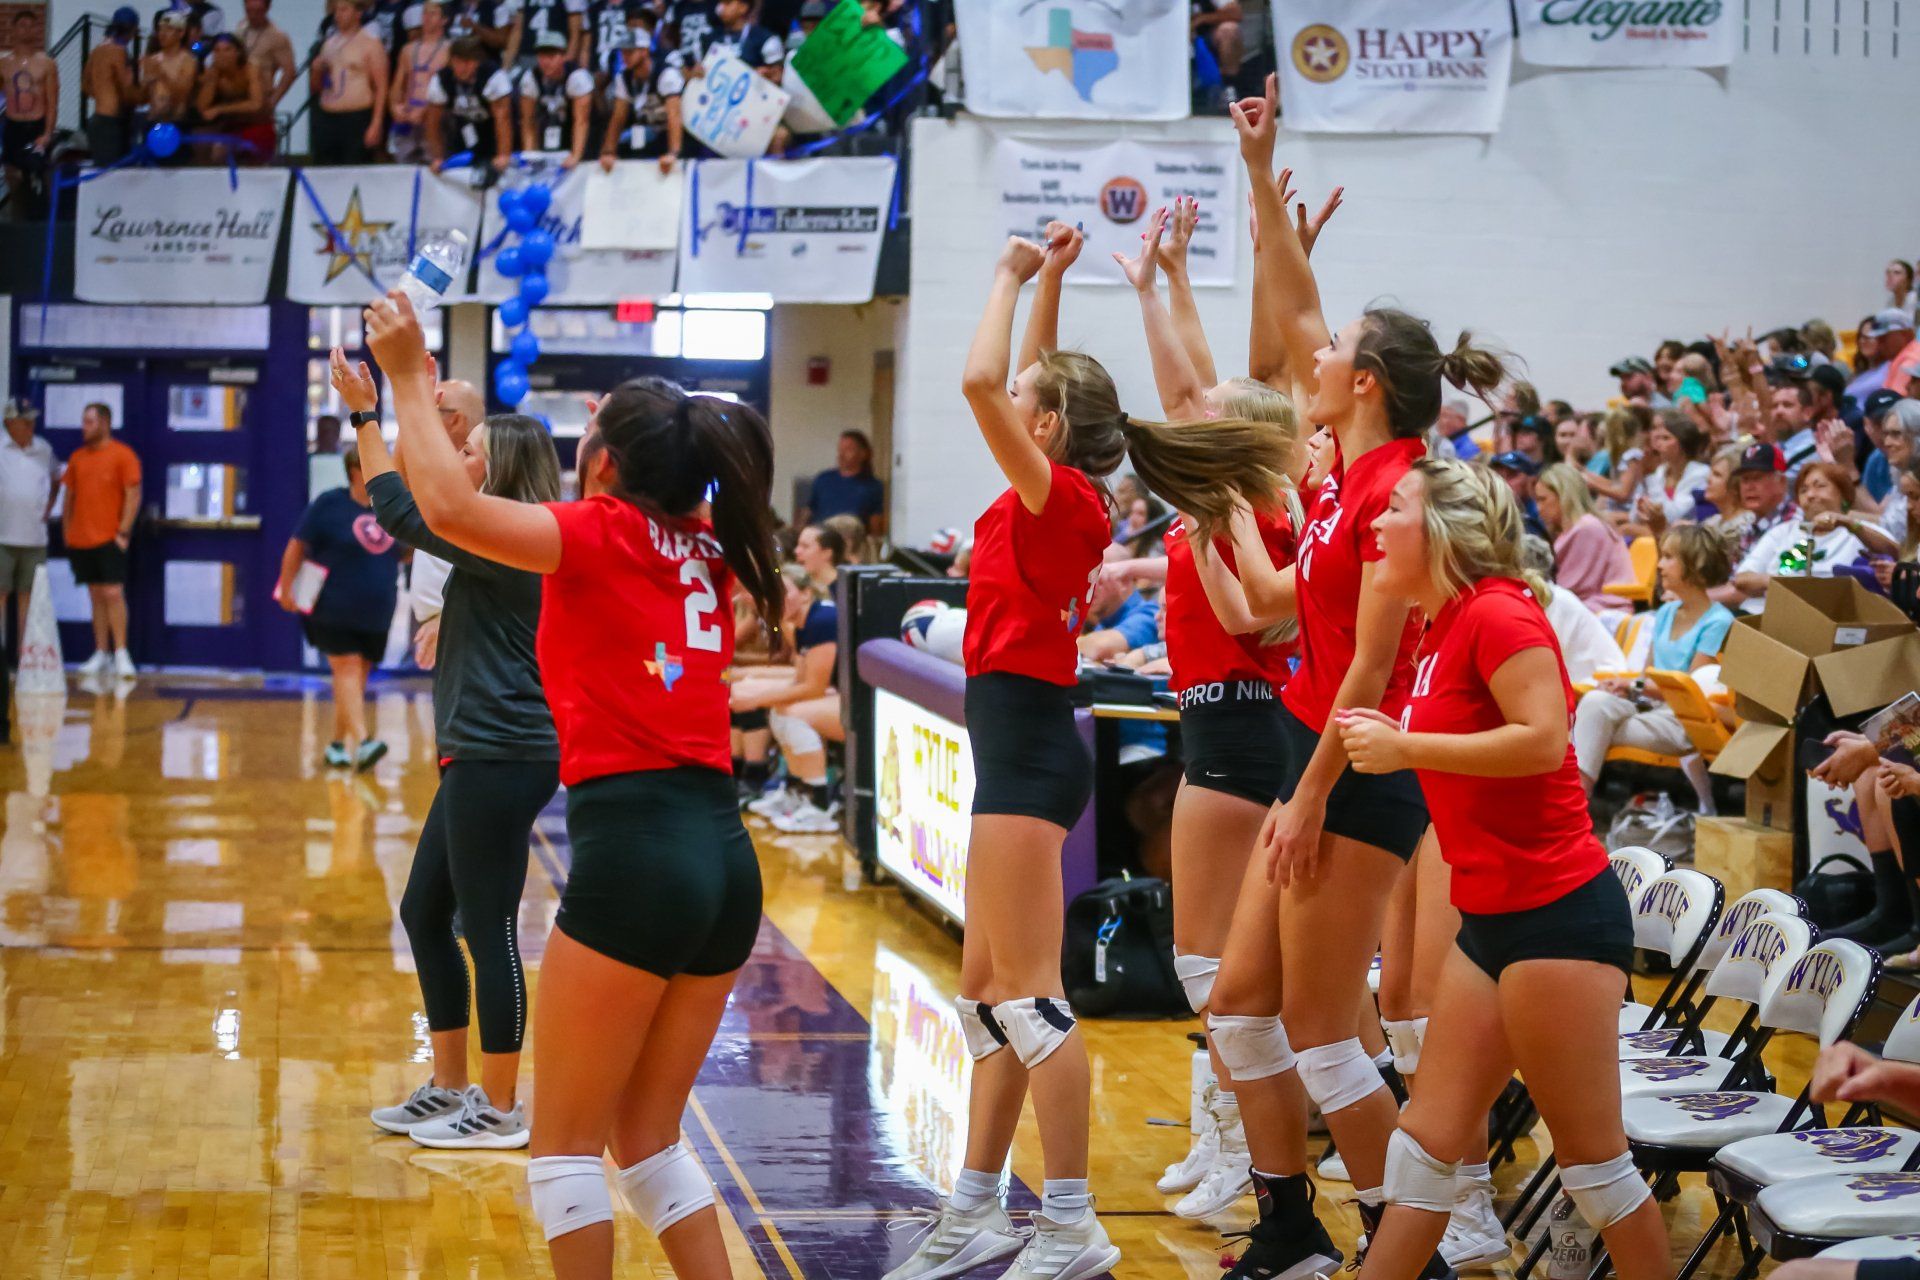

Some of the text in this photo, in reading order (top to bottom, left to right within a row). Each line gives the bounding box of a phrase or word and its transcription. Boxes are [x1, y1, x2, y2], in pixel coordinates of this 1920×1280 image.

[1356, 28, 1490, 60] HAPPY
[1355, 61, 1487, 80] STATE BANK
[1108, 189, 1138, 216] W
[91, 206, 275, 243] Lawrence Hall
[680, 559, 722, 653] 2
[1236, 680, 1273, 701] NIKE
[1552, 1247, 1587, 1262] ZERO
